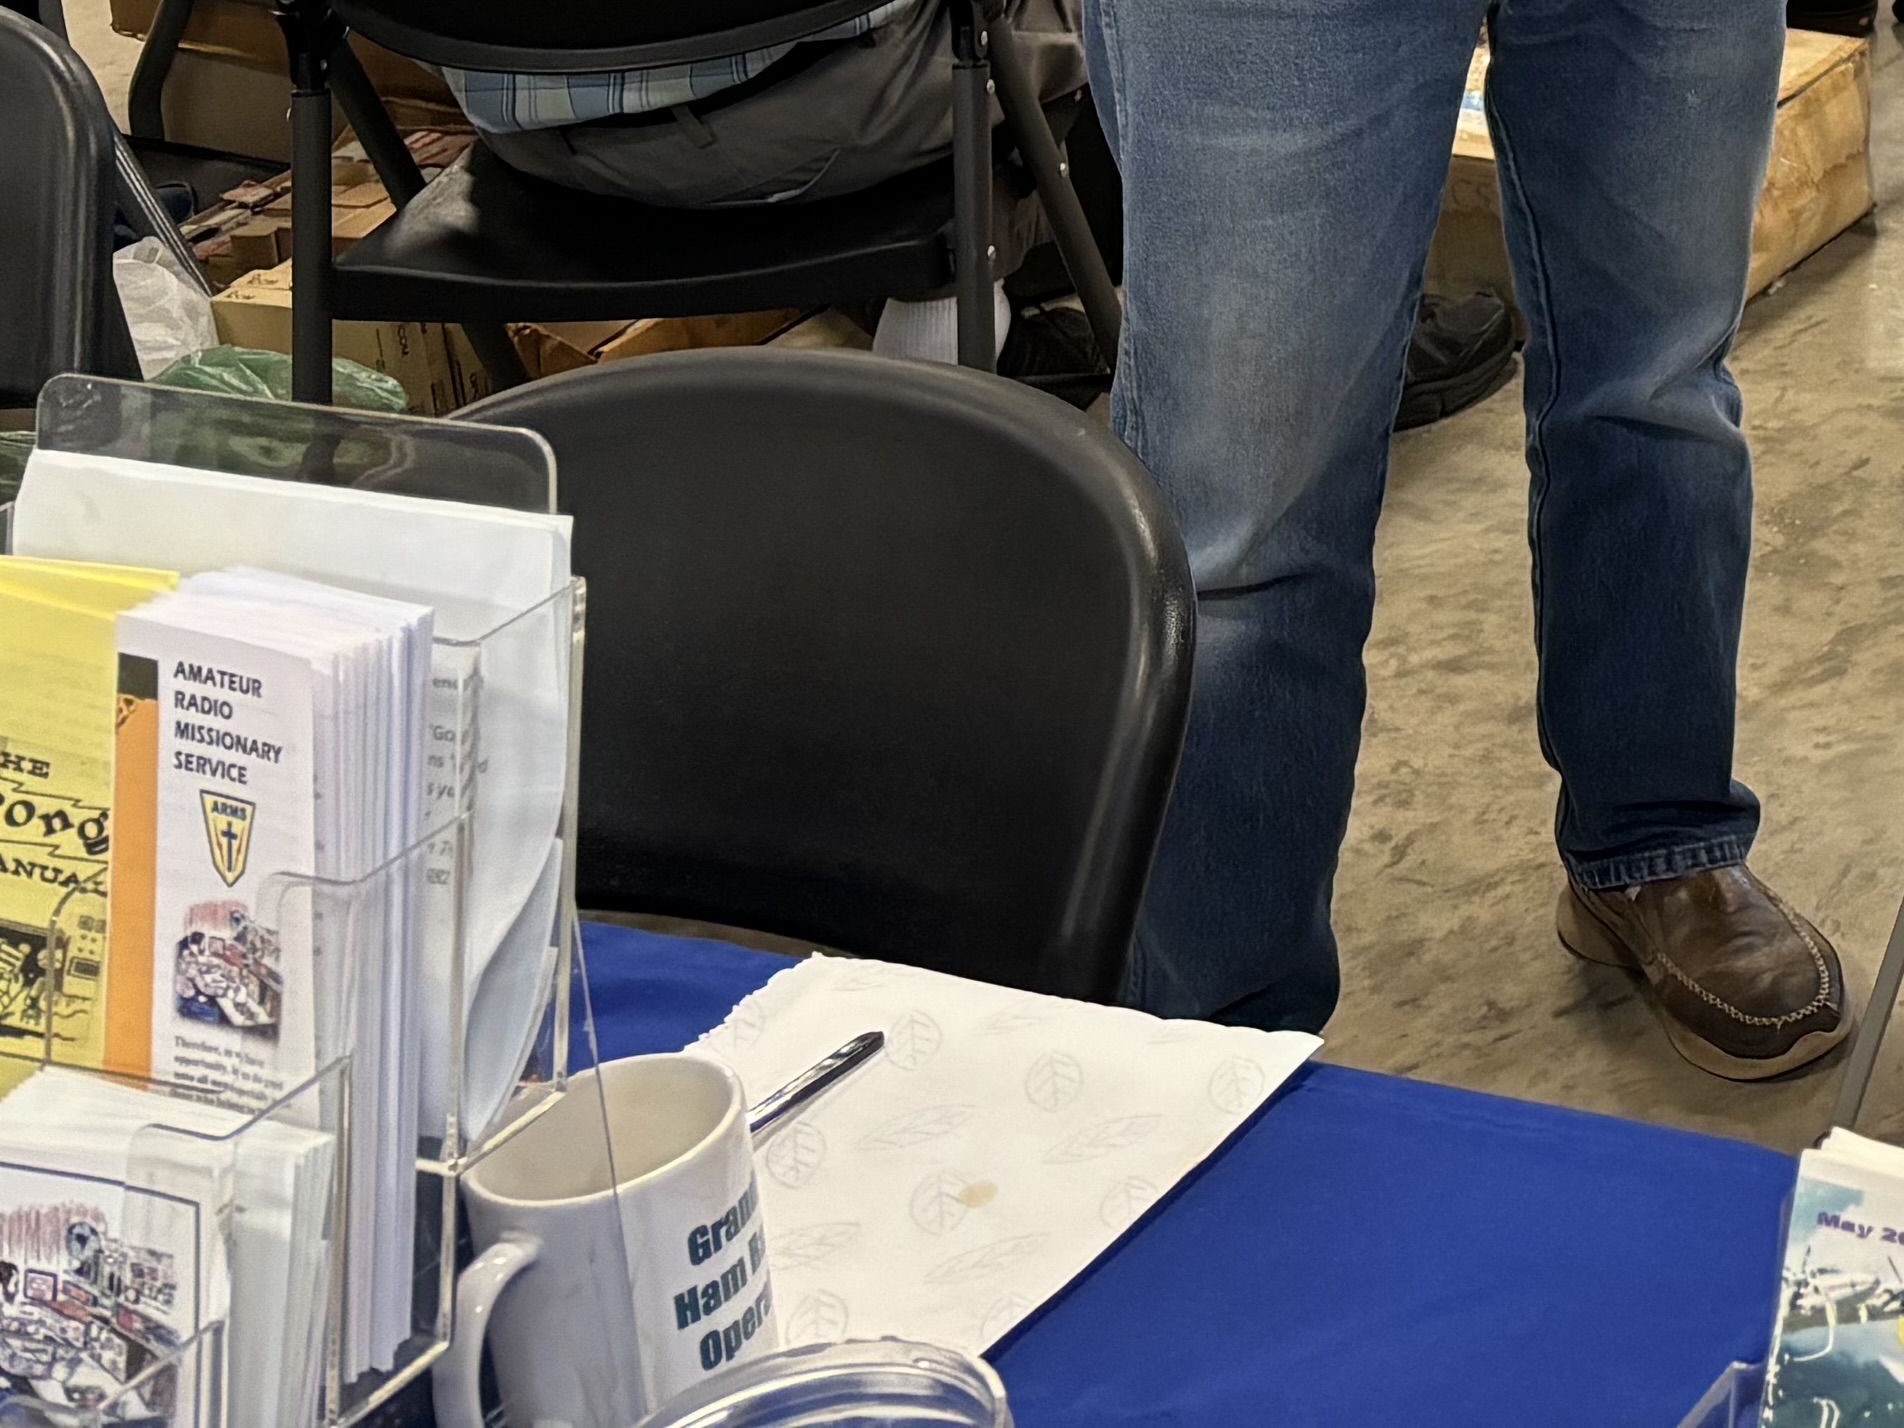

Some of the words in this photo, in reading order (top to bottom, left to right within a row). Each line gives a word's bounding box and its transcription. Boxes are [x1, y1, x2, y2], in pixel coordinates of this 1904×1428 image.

[173, 660, 262, 698] AMATEUR
[174, 690, 233, 720] RADIO
[174, 720, 283, 764] MISSIONARY
[173, 750, 248, 785] SERVICE
[0, 794, 109, 855] ong
[211, 800, 247, 821] ARMS
[1816, 1211, 1873, 1240] May
[673, 1256, 747, 1330] Ham
